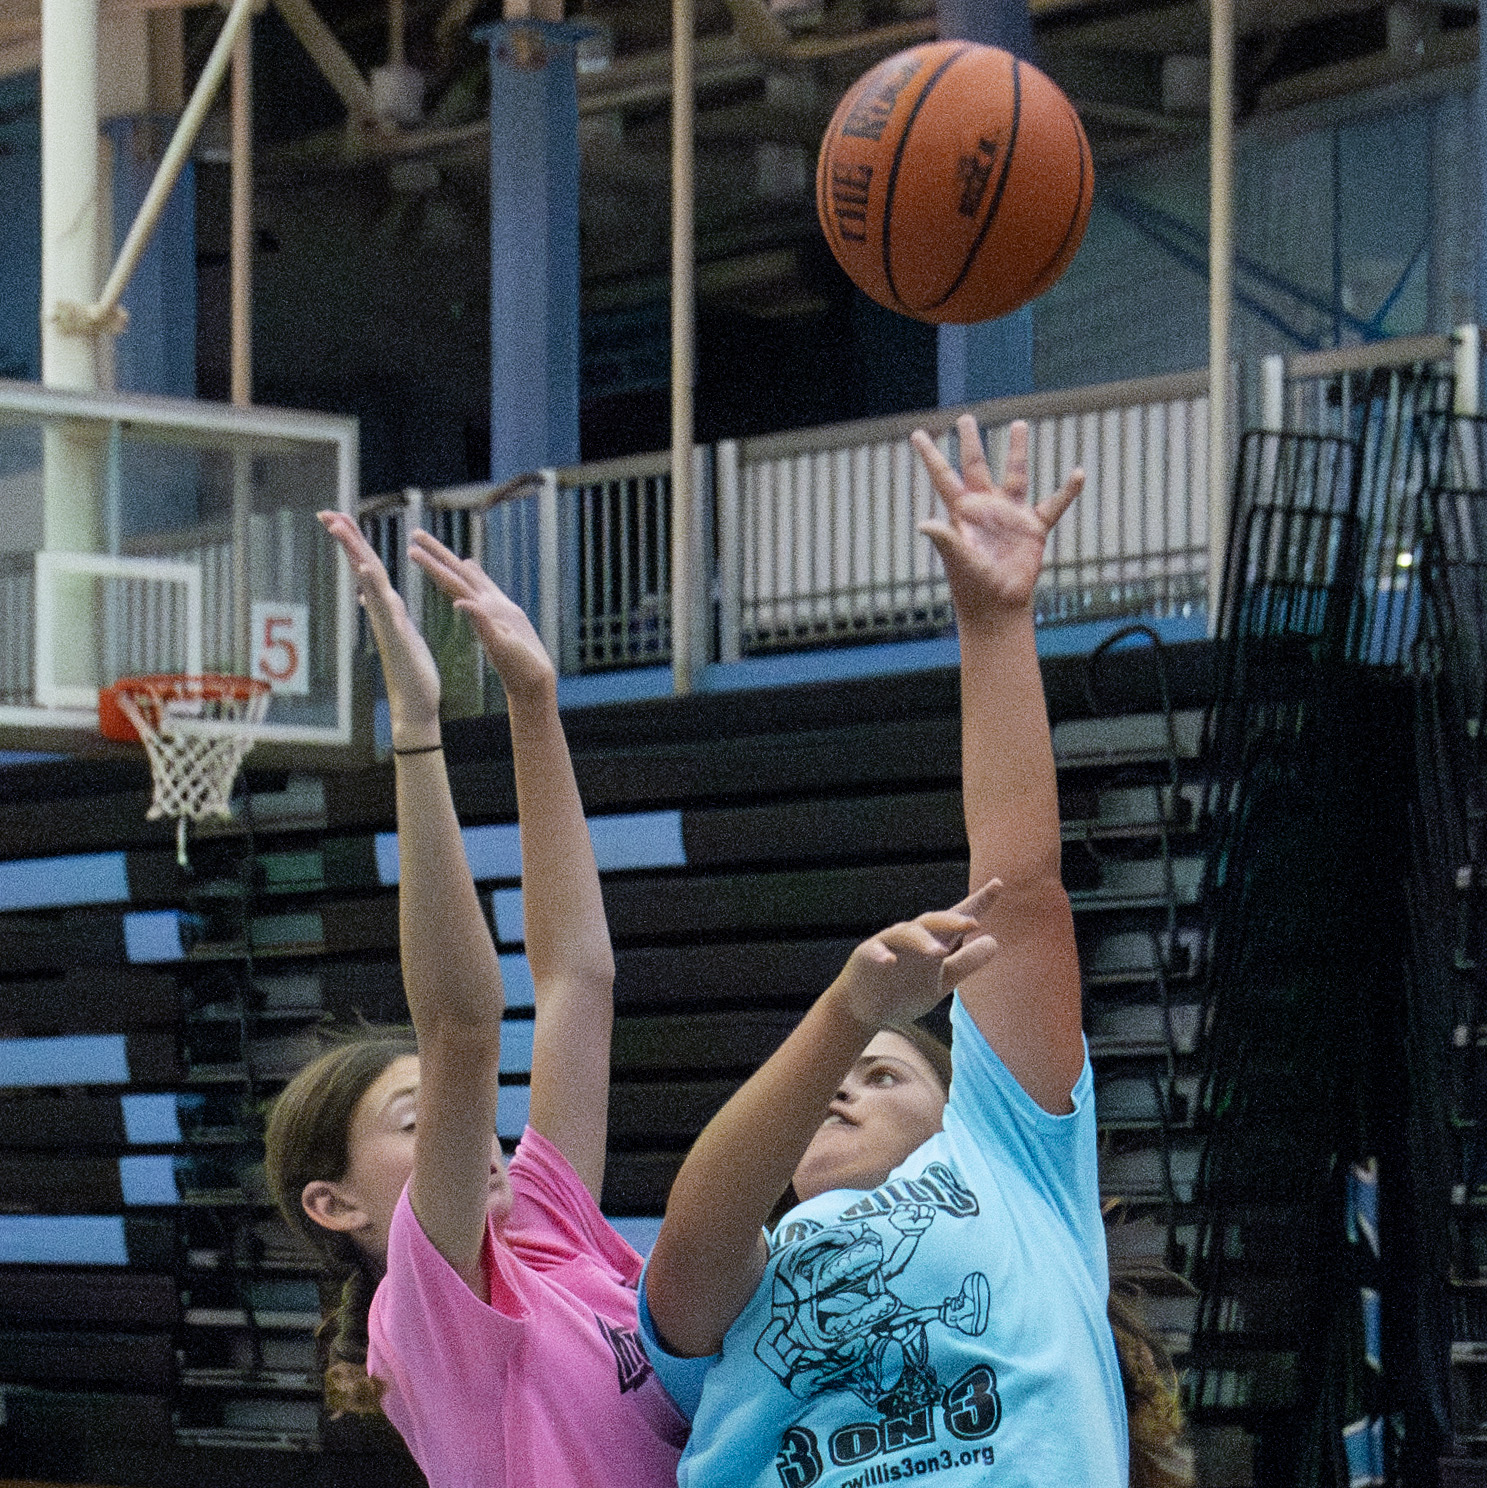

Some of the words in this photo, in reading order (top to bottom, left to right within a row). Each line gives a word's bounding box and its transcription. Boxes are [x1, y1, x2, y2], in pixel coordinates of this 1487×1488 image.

[260, 616, 299, 682] 5
[828, 1404, 937, 1468] ON
[942, 1364, 1003, 1441] 3
